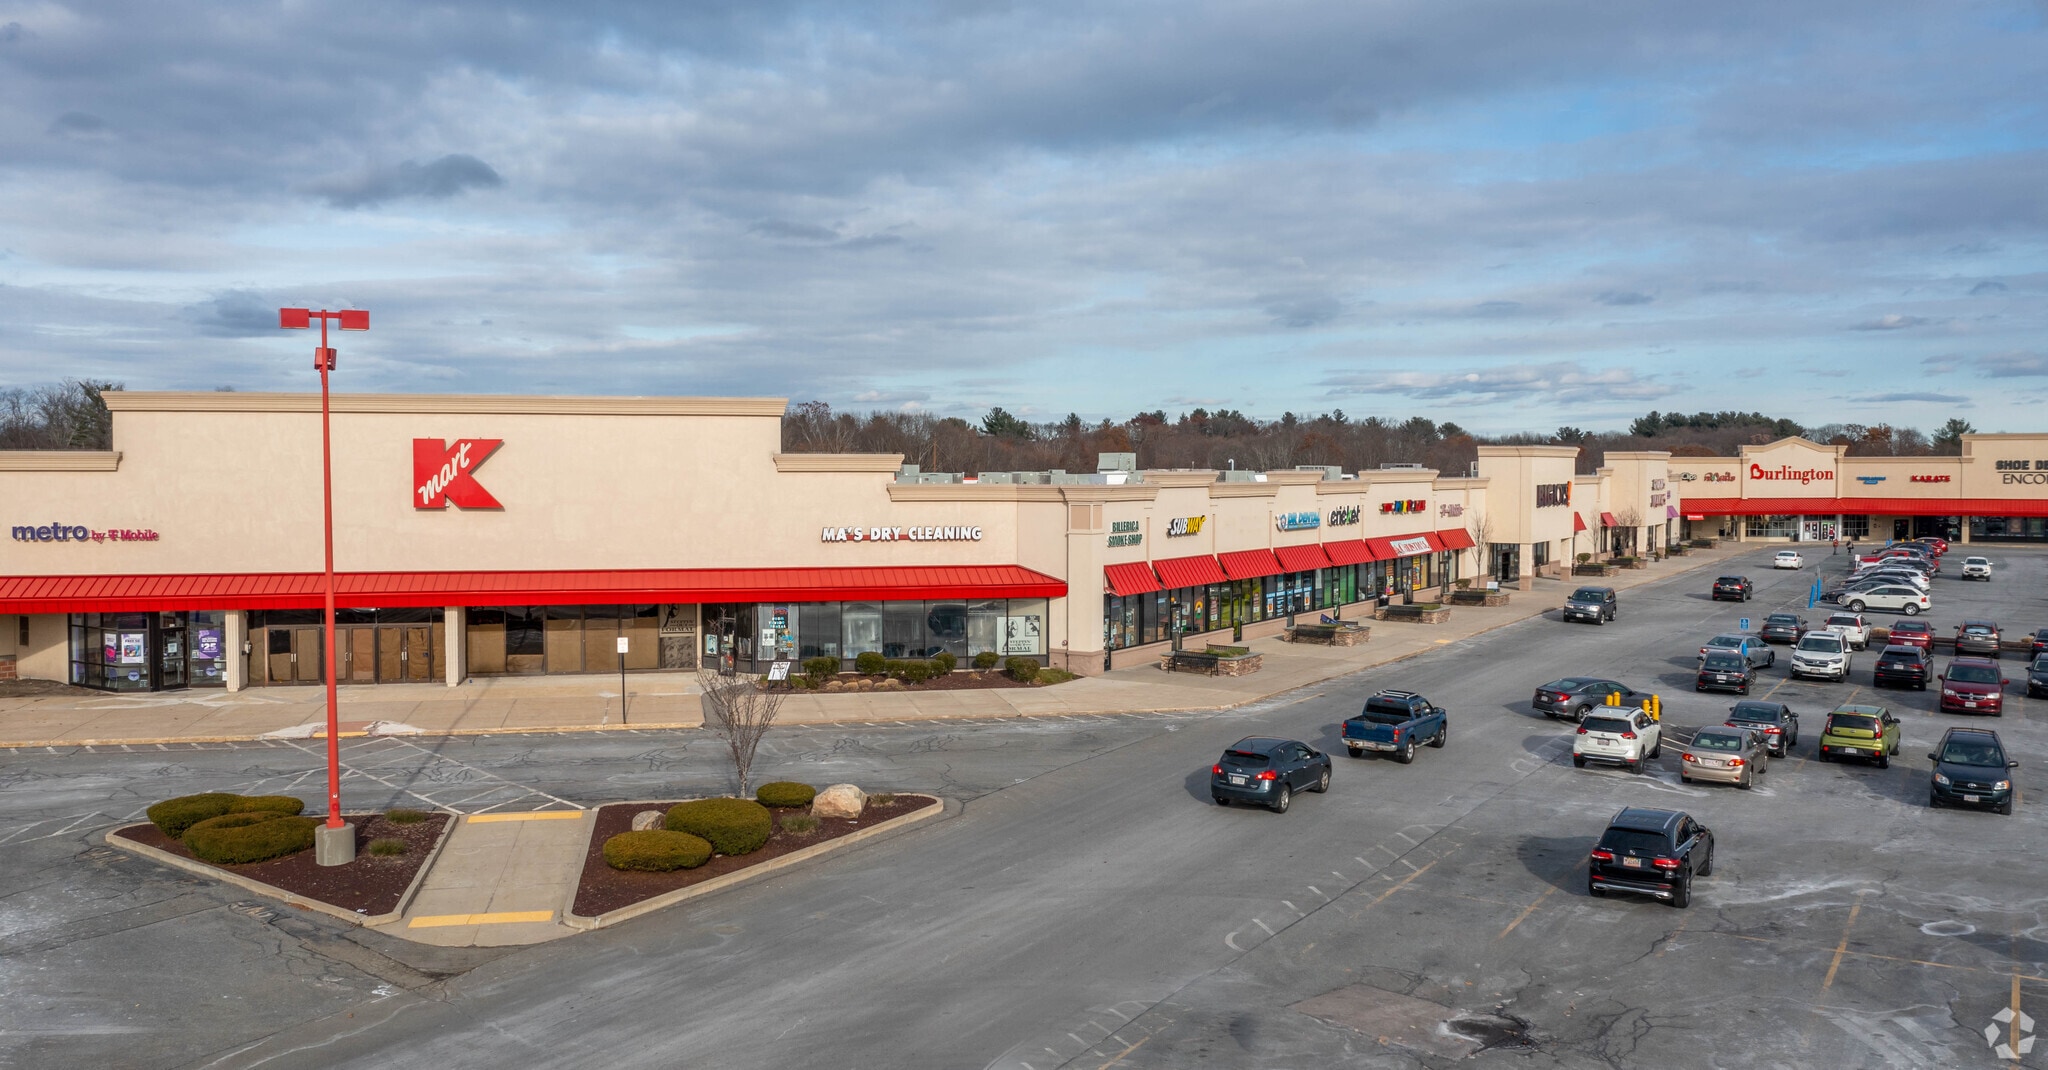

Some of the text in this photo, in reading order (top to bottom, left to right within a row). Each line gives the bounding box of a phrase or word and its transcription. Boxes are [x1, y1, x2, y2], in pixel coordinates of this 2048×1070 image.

[418, 442, 472, 504] mart
[1996, 460, 2030, 470] SHOE
[1750, 463, 1834, 485] Burlington
[2003, 473, 2048, 484] ENCO
[1329, 505, 1360, 526] cricket
[12, 522, 88, 541] metro
[91, 529, 105, 543] by
[822, 526, 983, 541] MA'S DRY CLEANING
[1111, 520, 1139, 532] BILLERICA
[1170, 515, 1206, 535] SUBWAY
[1108, 533, 1142, 546] SMOKE SHOP
